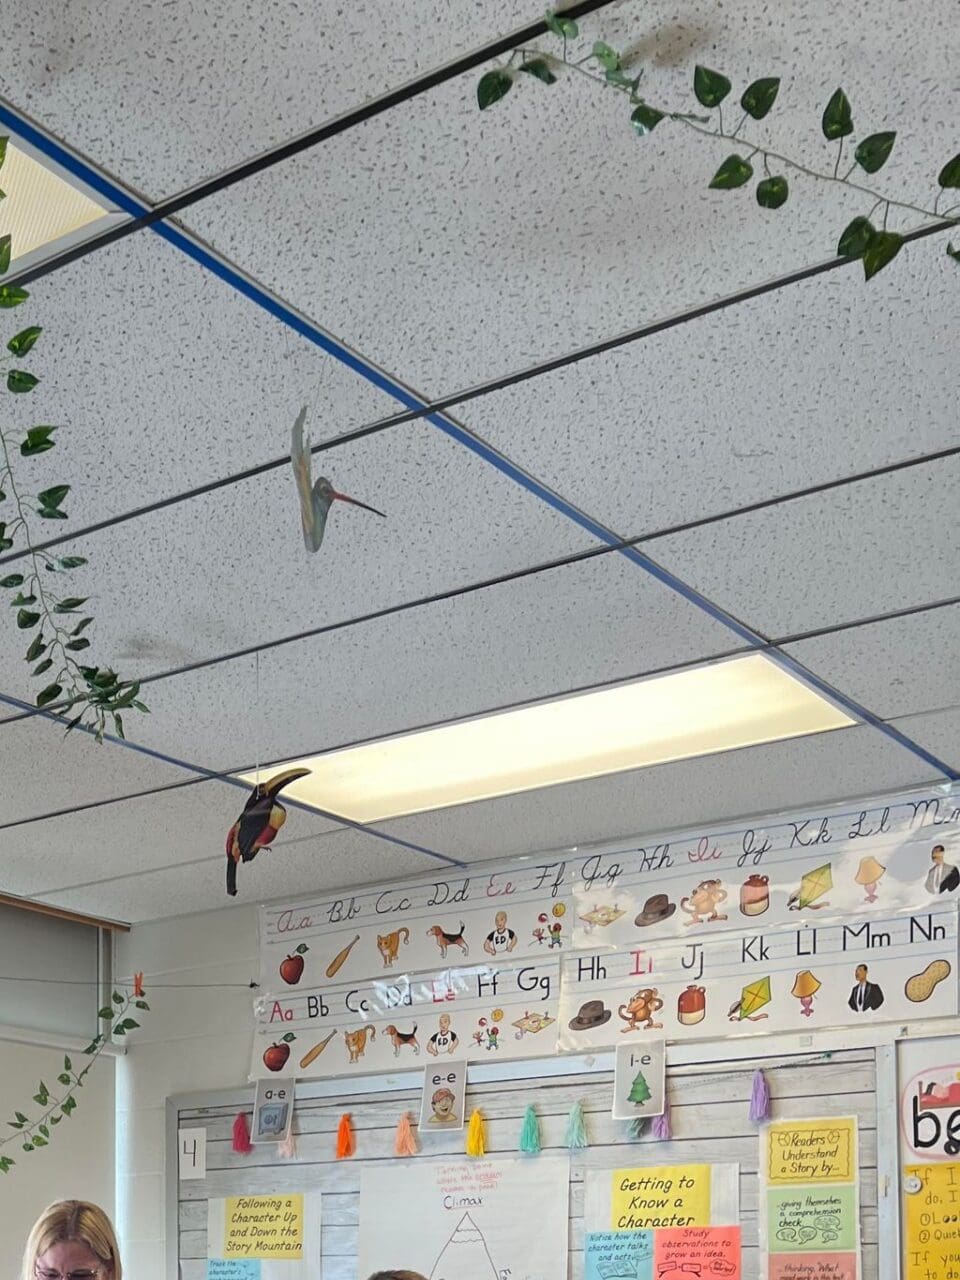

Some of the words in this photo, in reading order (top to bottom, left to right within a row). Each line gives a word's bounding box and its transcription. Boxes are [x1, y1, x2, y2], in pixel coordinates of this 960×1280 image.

[327, 897, 361, 923] Bb
[376, 891, 411, 913] Cc
[427, 879, 470, 906] Dd
[788, 817, 832, 848] Kk
[495, 934, 506, 945] ED
[270, 1001, 293, 1023] Aa
[307, 995, 329, 1018] Bb
[345, 990, 369, 1012] Cc
[517, 967, 550, 1001] Gg
[578, 956, 606, 981] Hh
[629, 949, 653, 976] Ii
[681, 943, 704, 981] Jj
[742, 936, 770, 963] Kk
[797, 929, 816, 955] Ll
[843, 922, 890, 951] Mm
[910, 914, 946, 943] Nn
[432, 1073, 456, 1085] e-e
[264, 1089, 286, 1100] a-e
[791, 1131, 826, 1147] Readers
[183, 1139, 196, 1167] 4
[783, 1145, 839, 1161] Understand
[790, 1162, 818, 1176] Story
[946, 1167, 957, 1186] I
[620, 1177, 672, 1193] Getting
[680, 1176, 695, 1188] to
[948, 1190, 958, 1202] I
[236, 1198, 282, 1211] Following
[285, 1200, 292, 1208] a
[443, 1195, 483, 1210] Climax
[629, 1197, 668, 1209] Know
[674, 1198, 683, 1207] a
[231, 1213, 282, 1223] Character
[283, 1212, 298, 1226] Up
[617, 1214, 695, 1228] Character
[230, 1227, 248, 1237] and
[250, 1227, 277, 1237] Down
[280, 1226, 298, 1237] the
[590, 1233, 611, 1242] Notice
[615, 1233, 630, 1241] how
[633, 1231, 647, 1240] the
[683, 1230, 709, 1240] Study
[226, 1241, 252, 1254] Story
[254, 1241, 302, 1251] Mountain
[588, 1244, 625, 1252] character
[627, 1242, 649, 1250] talks
[662, 1240, 719, 1249] observations
[721, 1240, 732, 1248] to
[598, 1253, 612, 1261] and
[665, 1252, 686, 1260] grow
[924, 1268, 937, 1280] to
